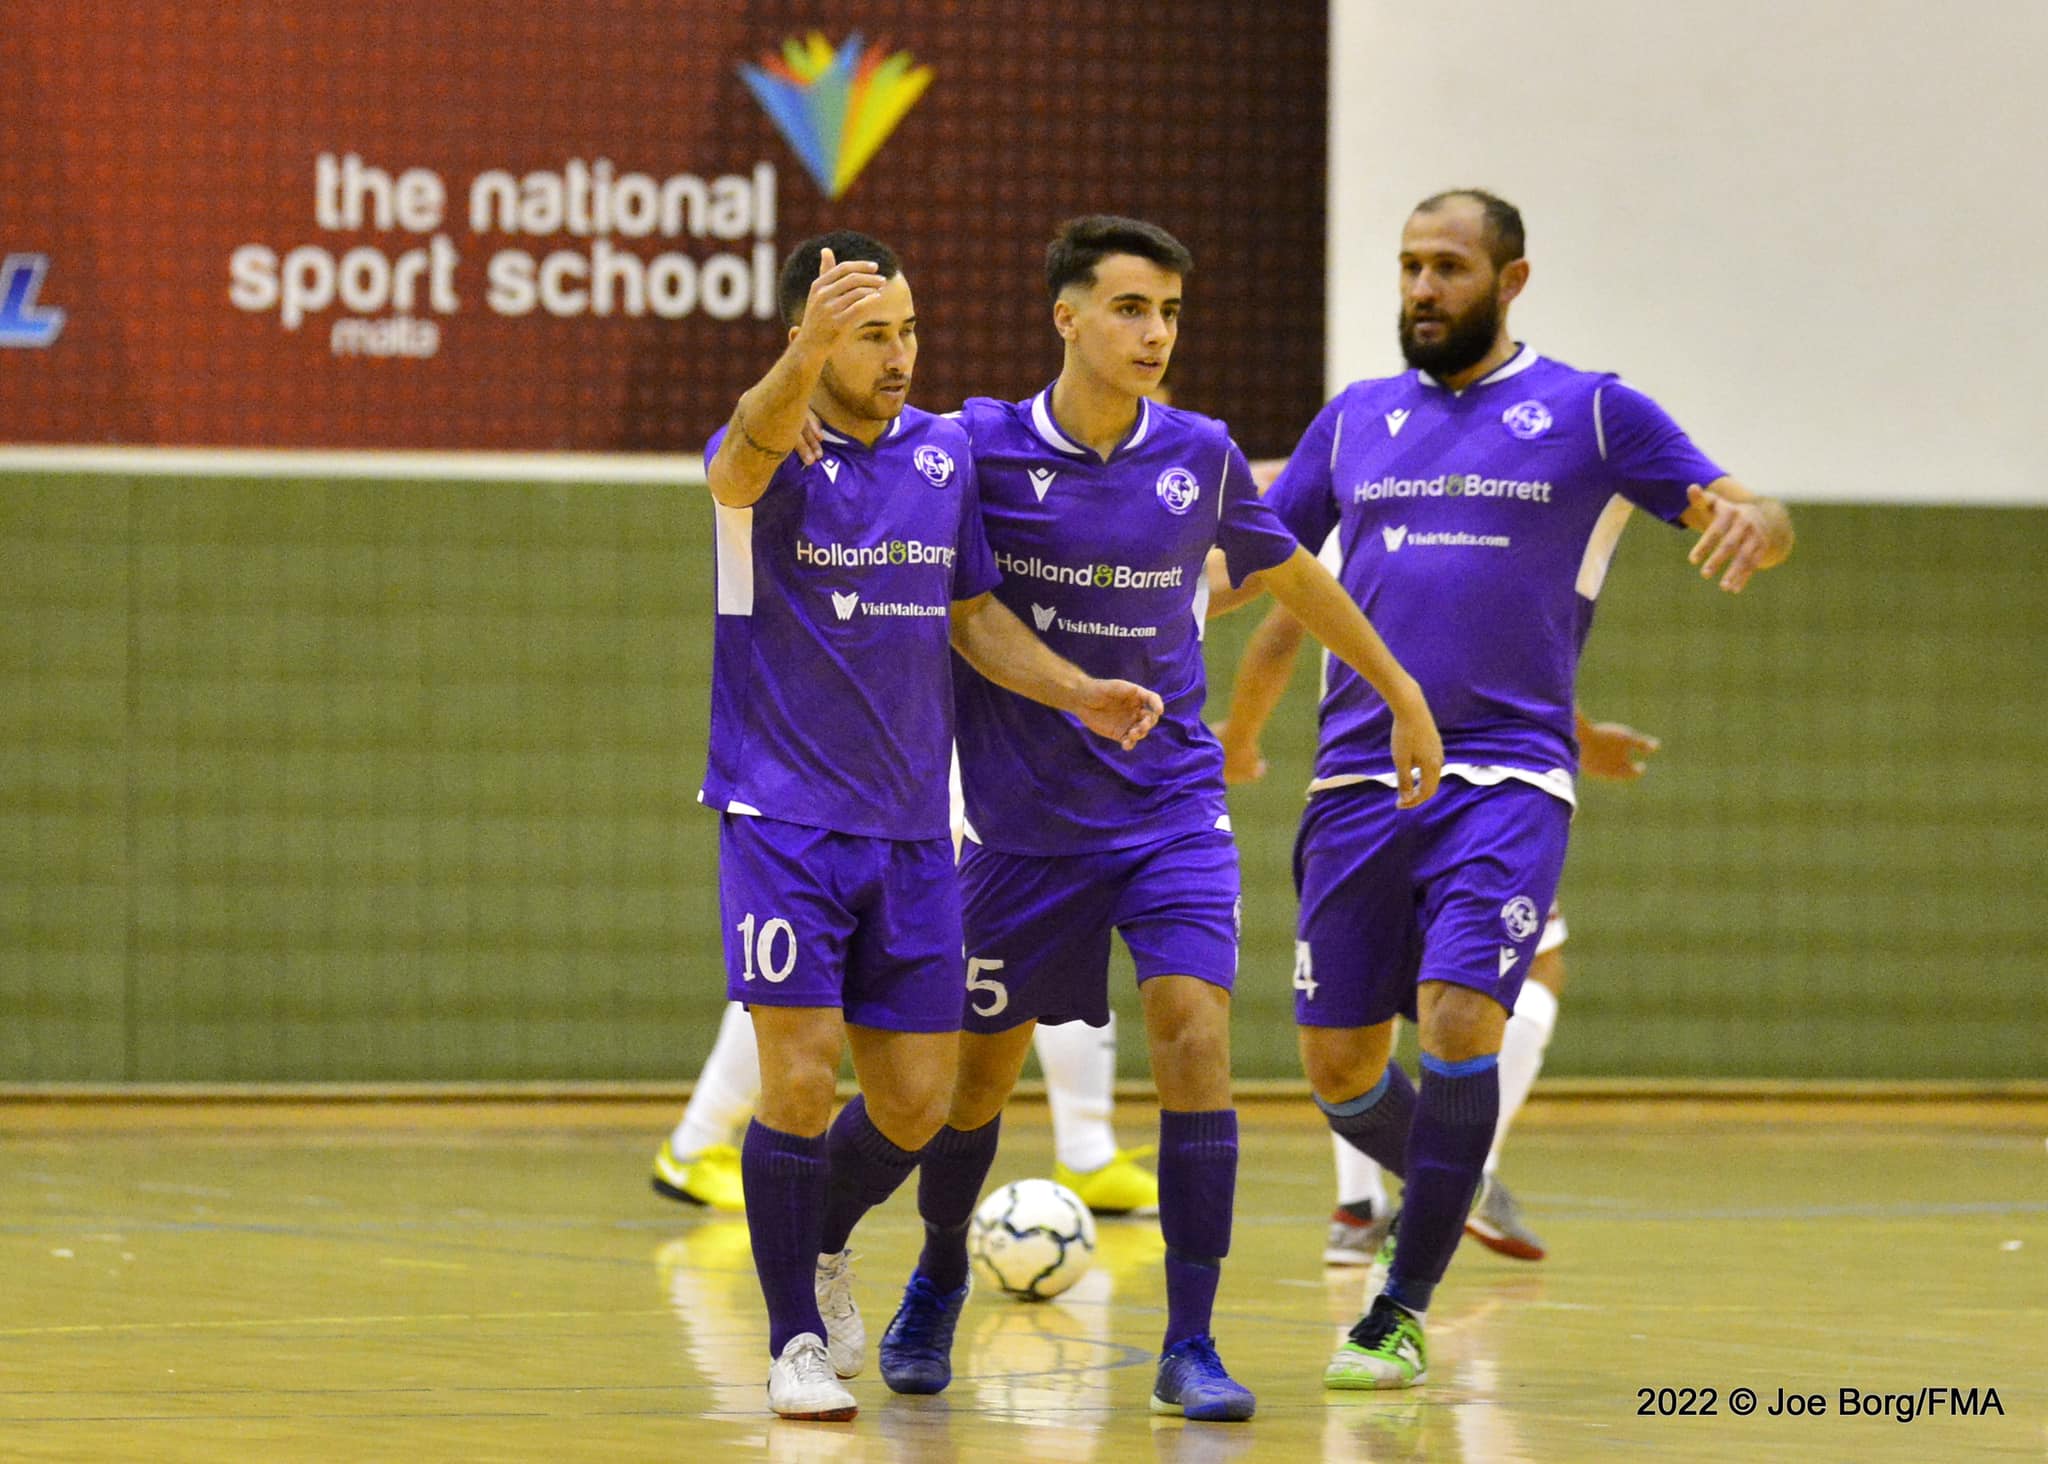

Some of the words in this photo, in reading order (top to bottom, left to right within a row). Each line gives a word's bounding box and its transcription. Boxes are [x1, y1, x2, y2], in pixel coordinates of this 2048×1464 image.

[314, 152, 447, 232] the
[469, 156, 777, 239] national
[228, 234, 460, 331] sport
[486, 237, 777, 320] school
[331, 313, 441, 358] malta
[1057, 617, 1157, 637] VisitMalta.com
[736, 912, 798, 983] 10
[962, 943, 1008, 1017] 5
